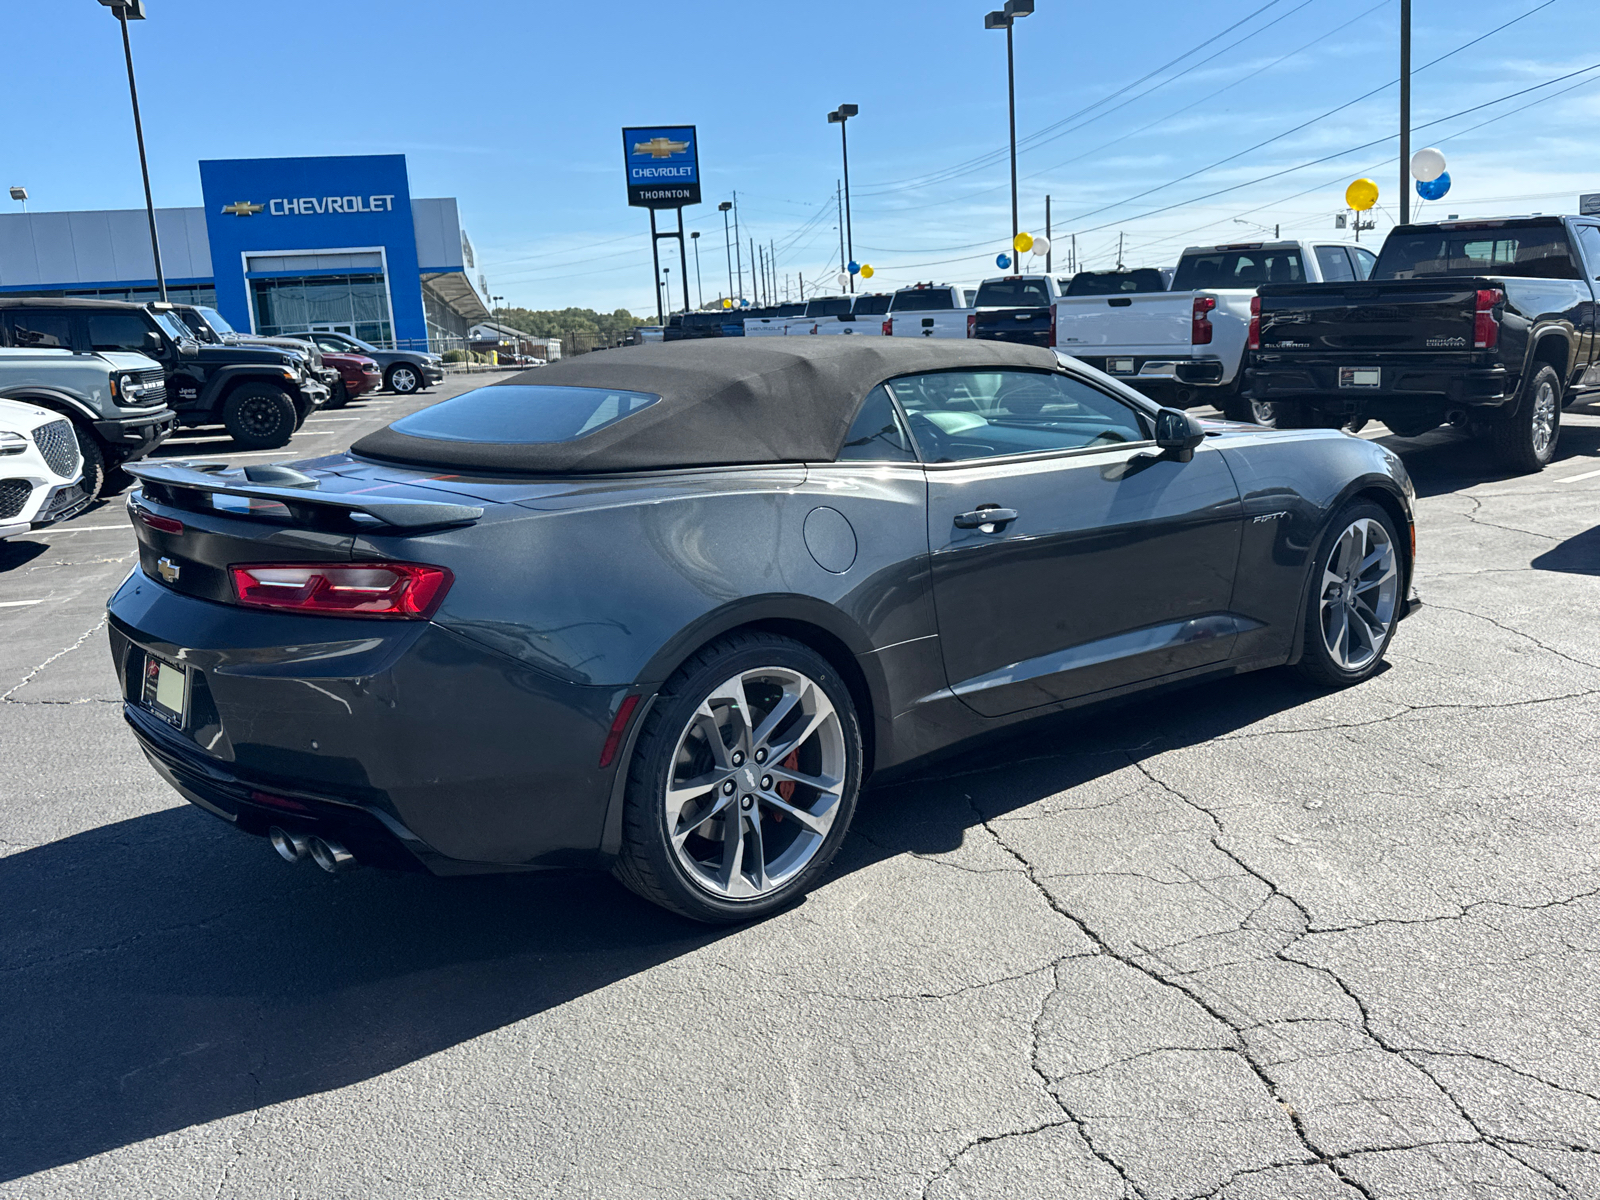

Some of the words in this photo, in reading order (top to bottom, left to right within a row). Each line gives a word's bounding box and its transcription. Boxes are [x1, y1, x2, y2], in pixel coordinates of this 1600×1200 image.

[632, 167, 692, 178] CHEVROLET
[639, 190, 690, 199] THORNTON
[269, 195, 395, 215] CHEVROLET
[1253, 511, 1287, 523] FIFTY
